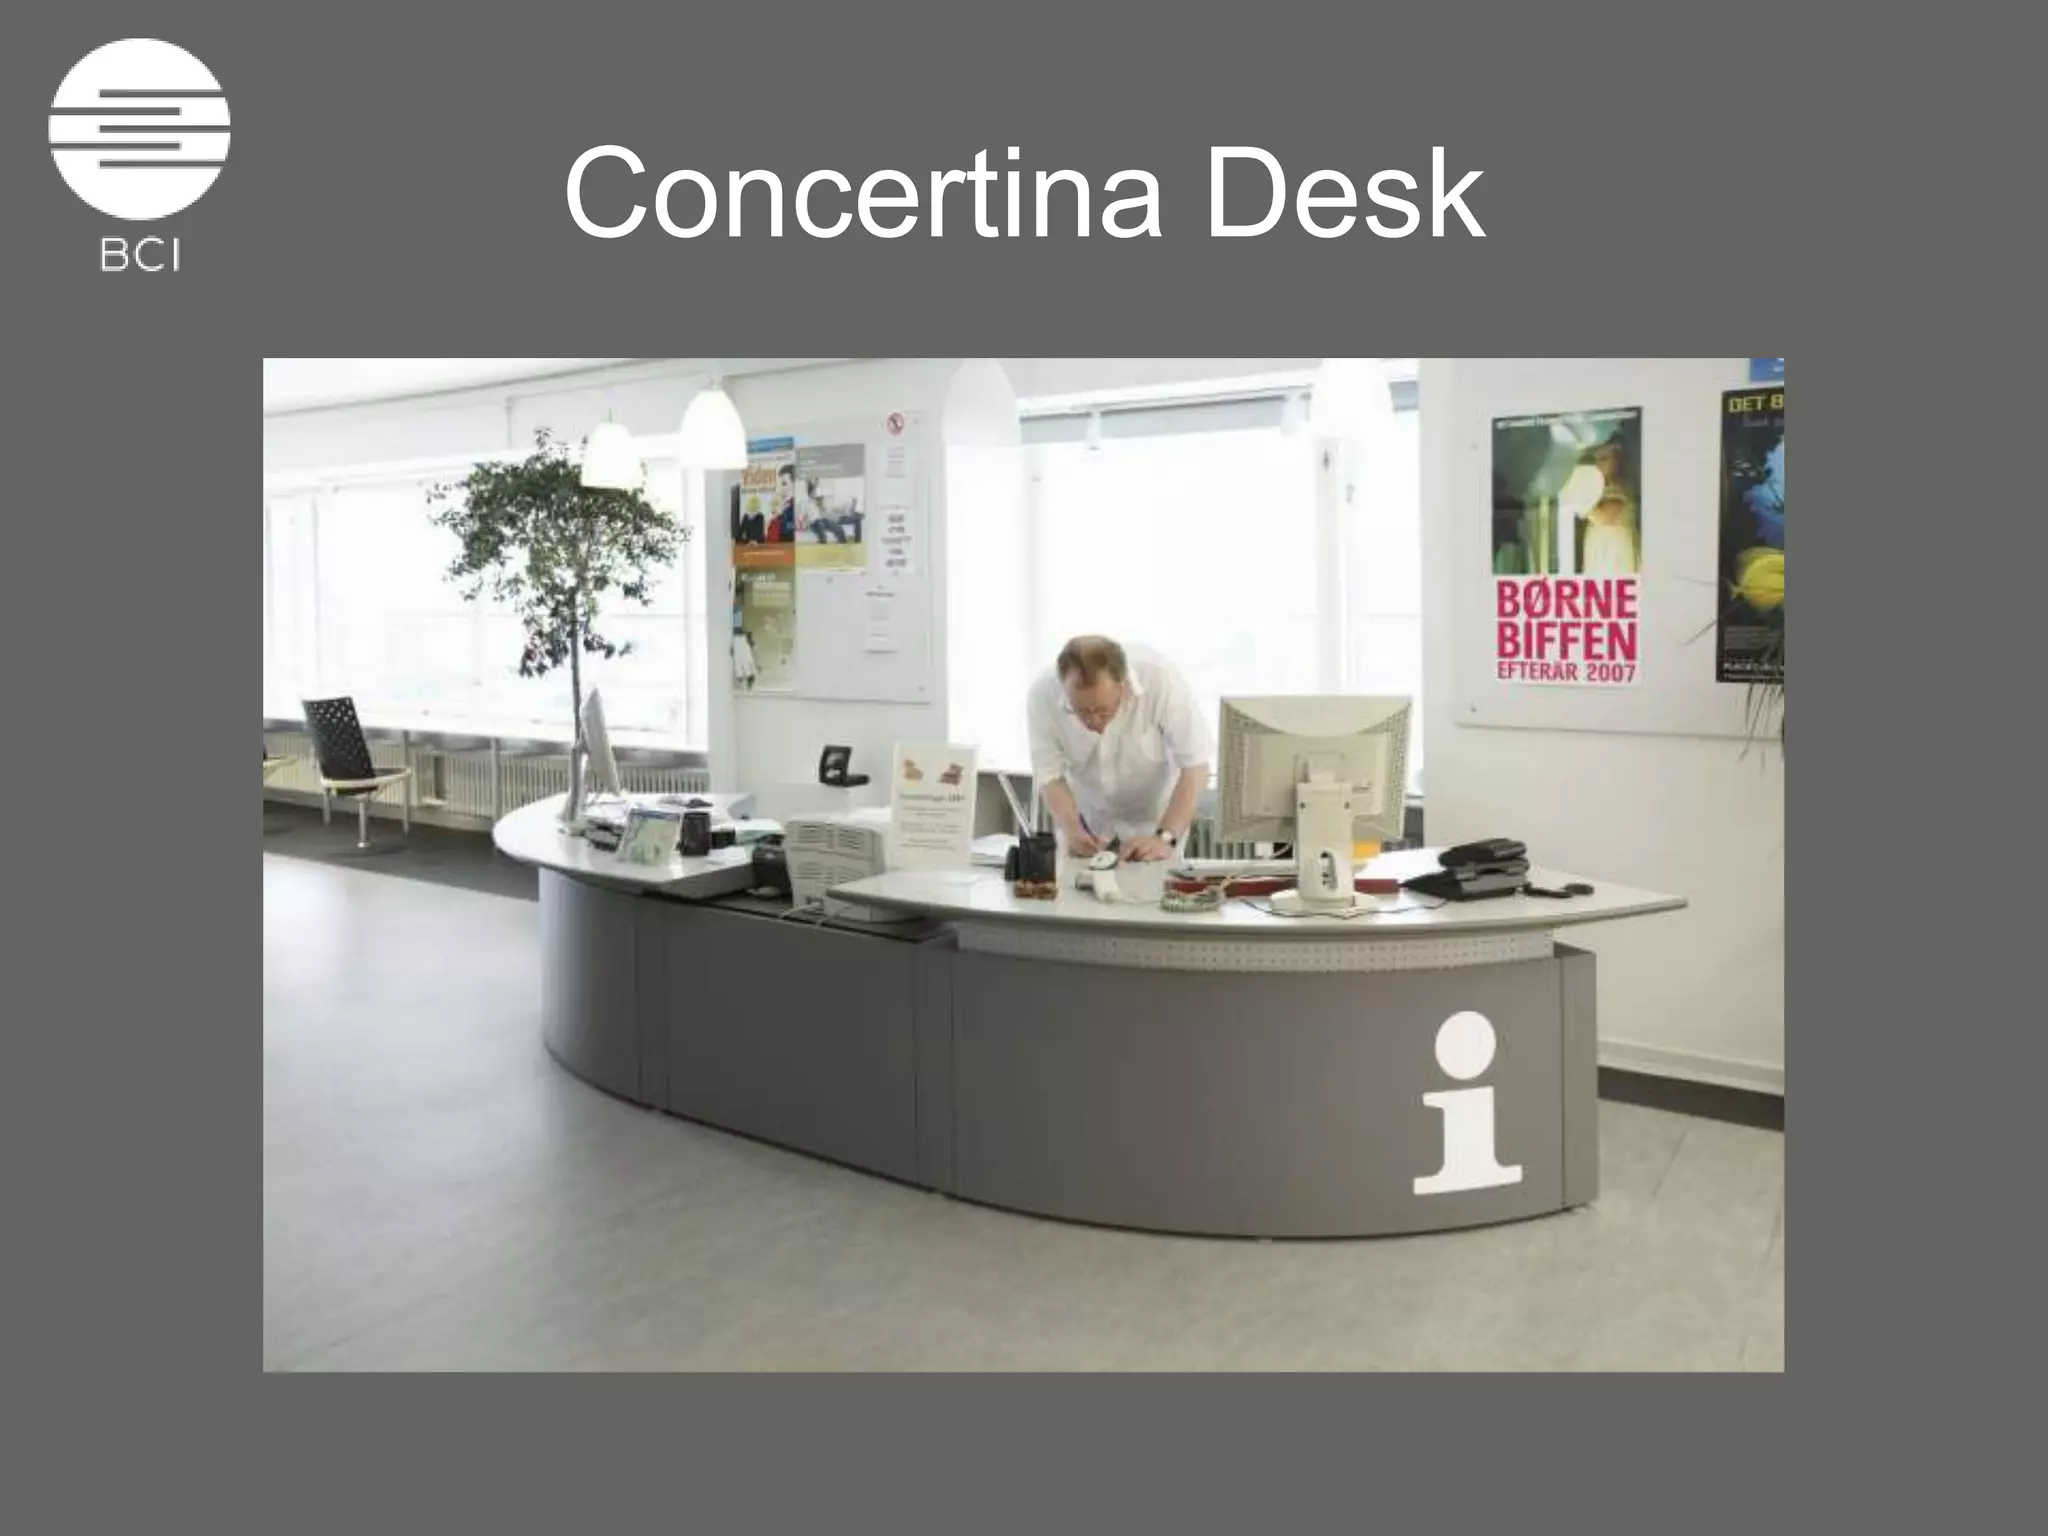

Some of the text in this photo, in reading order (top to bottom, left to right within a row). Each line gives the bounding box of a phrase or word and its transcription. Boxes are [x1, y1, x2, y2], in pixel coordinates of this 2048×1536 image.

[1729, 396, 1767, 413] DET
[1497, 577, 1637, 619] BØRNE
[1497, 620, 1637, 661] BIFFEN
[1586, 663, 1636, 683] 2007
